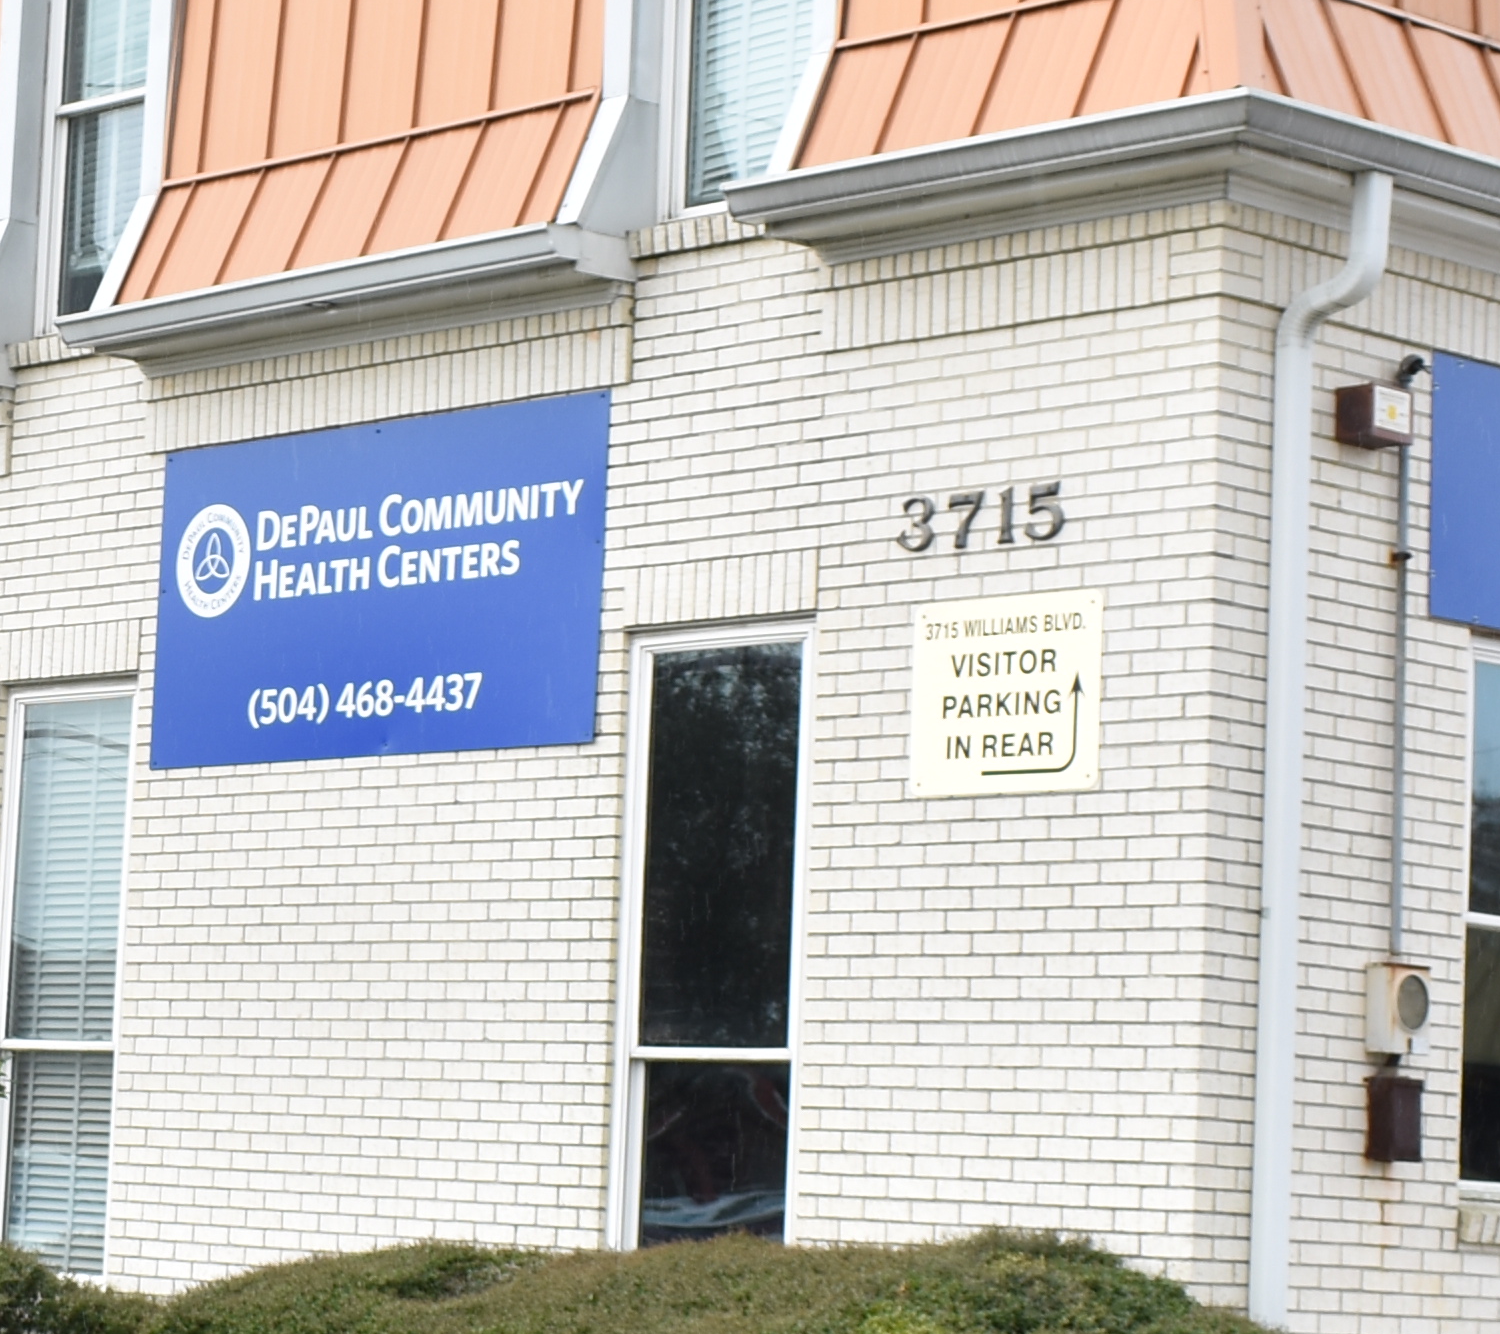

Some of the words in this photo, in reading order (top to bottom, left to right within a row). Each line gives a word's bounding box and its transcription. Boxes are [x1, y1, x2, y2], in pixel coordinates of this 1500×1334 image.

[378, 478, 584, 537] COMMUNITY
[896, 481, 1066, 552] 3715
[253, 556, 370, 602] HEALTH
[377, 540, 521, 589] CENTERS
[925, 622, 960, 641] 3715
[964, 616, 1039, 638] WILLIAMS
[1043, 612, 1087, 633] BLVD.
[951, 648, 1057, 678] VISITOR
[248, 683, 330, 728] (504)
[336, 672, 483, 717] 468-4437
[942, 689, 1062, 719] PARKING
[946, 735, 971, 759] IN
[982, 732, 1055, 758] REAR
